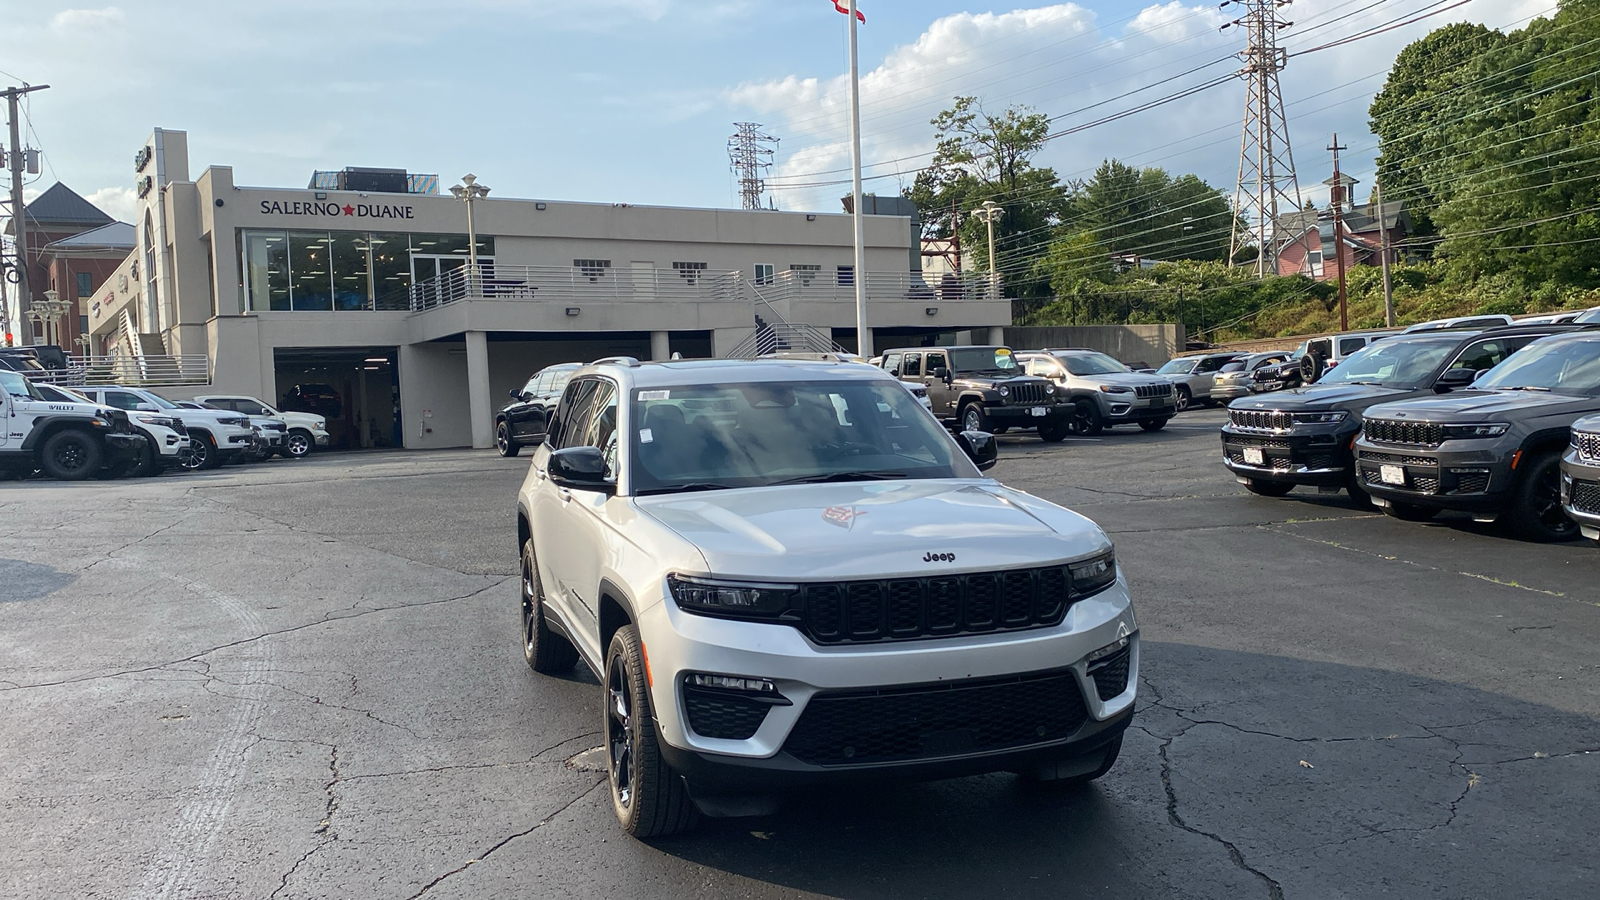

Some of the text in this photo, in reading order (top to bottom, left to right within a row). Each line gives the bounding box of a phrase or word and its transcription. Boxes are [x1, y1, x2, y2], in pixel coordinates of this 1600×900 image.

[260, 200, 414, 219] SALERNO DUANE
[922, 551, 956, 563] Jeep
